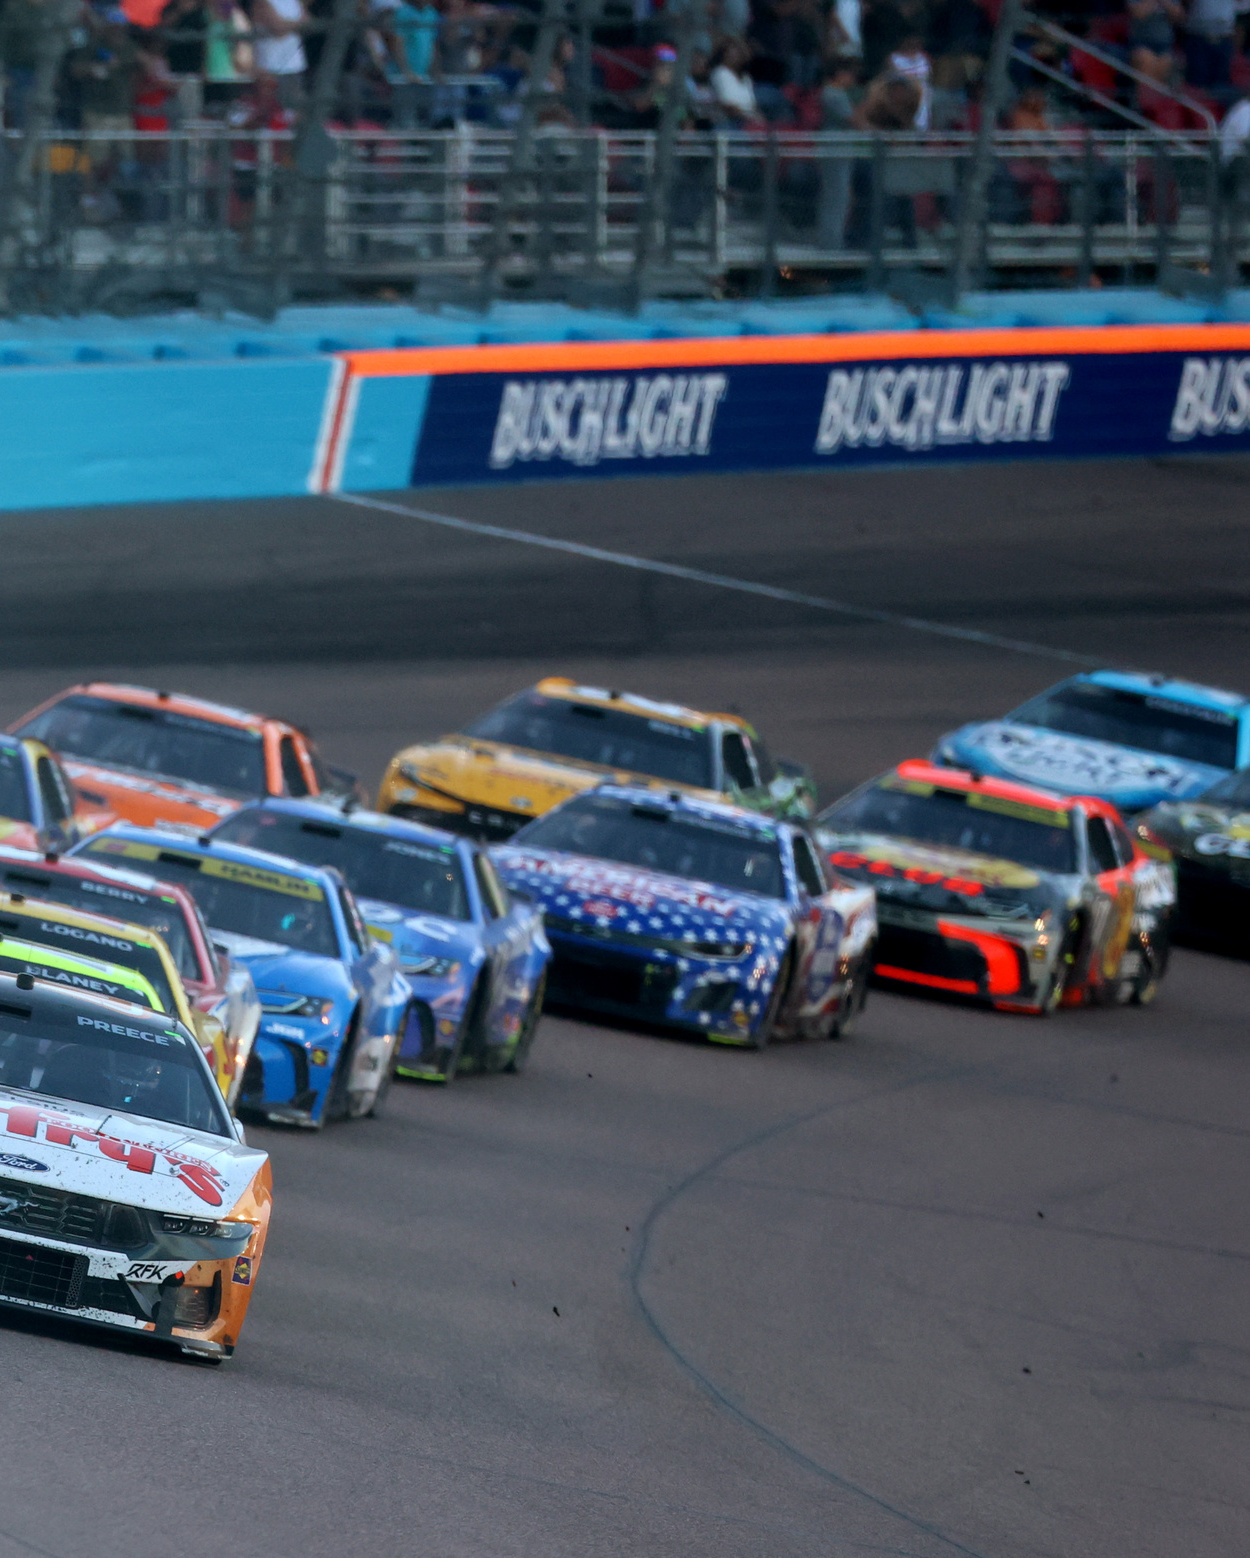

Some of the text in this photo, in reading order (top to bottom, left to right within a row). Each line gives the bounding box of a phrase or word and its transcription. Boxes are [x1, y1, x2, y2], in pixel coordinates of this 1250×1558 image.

[79, 880, 149, 905] BERRY
[40, 921, 133, 952] LOGANO
[25, 964, 119, 996] BLANEY
[76, 1015, 171, 1047] PREECE
[126, 1263, 168, 1280] RFK
